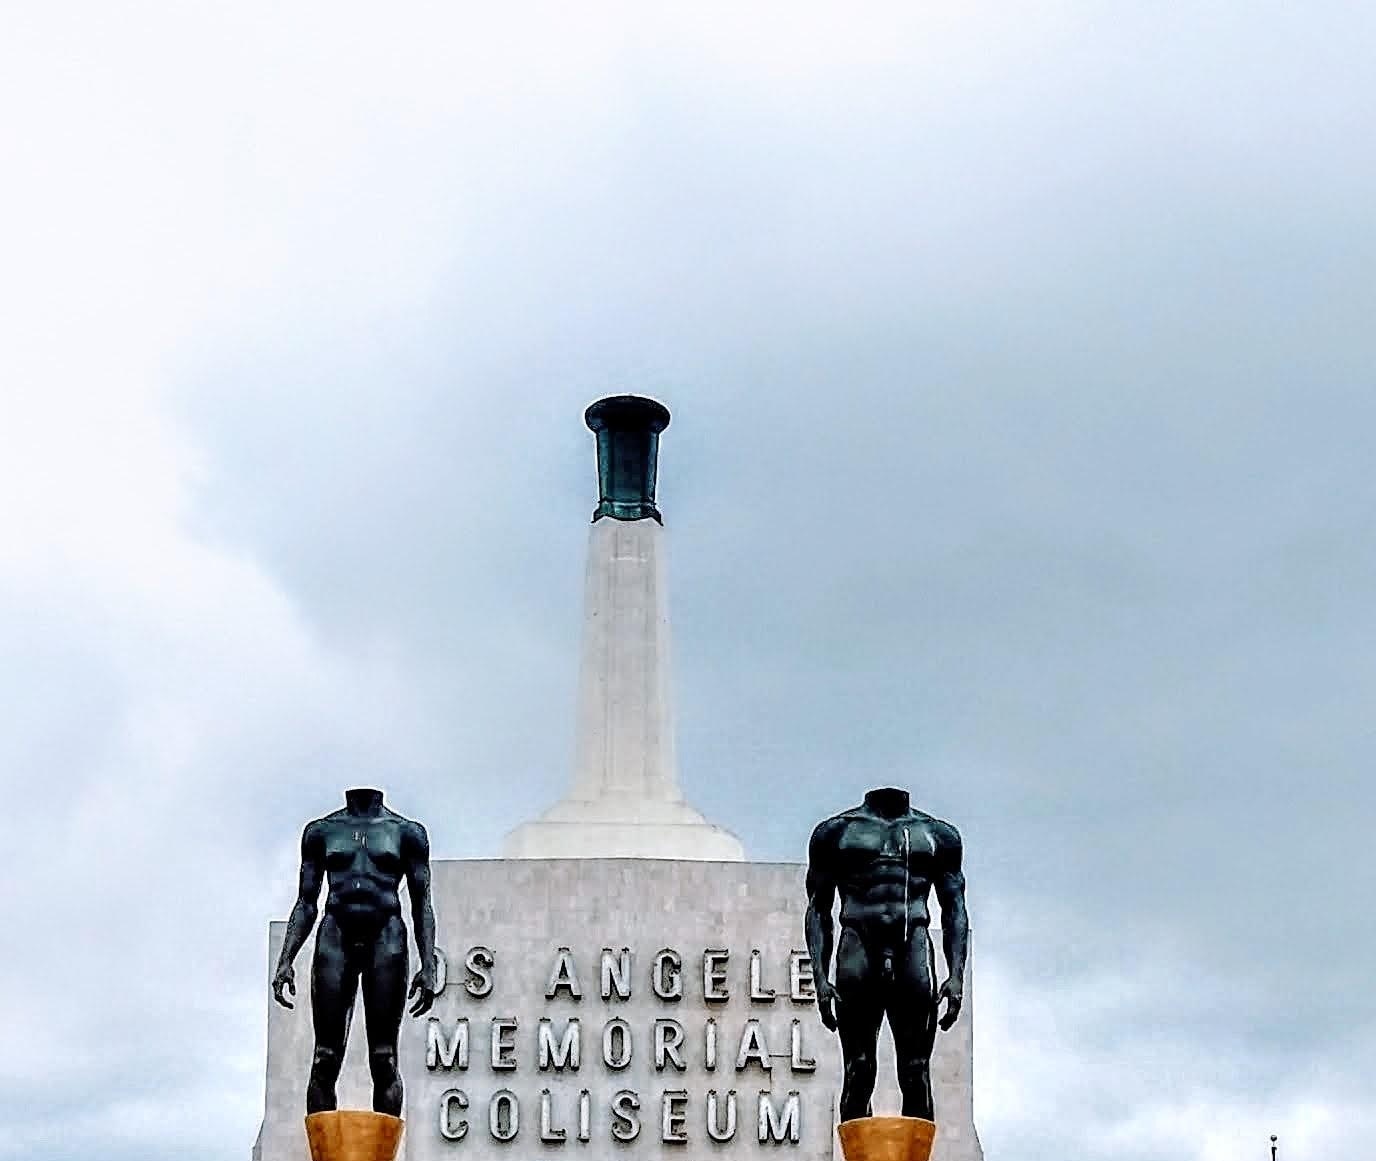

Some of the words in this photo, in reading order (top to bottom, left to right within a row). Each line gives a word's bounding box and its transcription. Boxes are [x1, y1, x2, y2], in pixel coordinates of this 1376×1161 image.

[432, 946, 495, 999] OS
[544, 947, 817, 1003] ANGELE
[426, 1016, 817, 1073] MEMORIAL
[439, 1088, 801, 1145] COLISEUM
